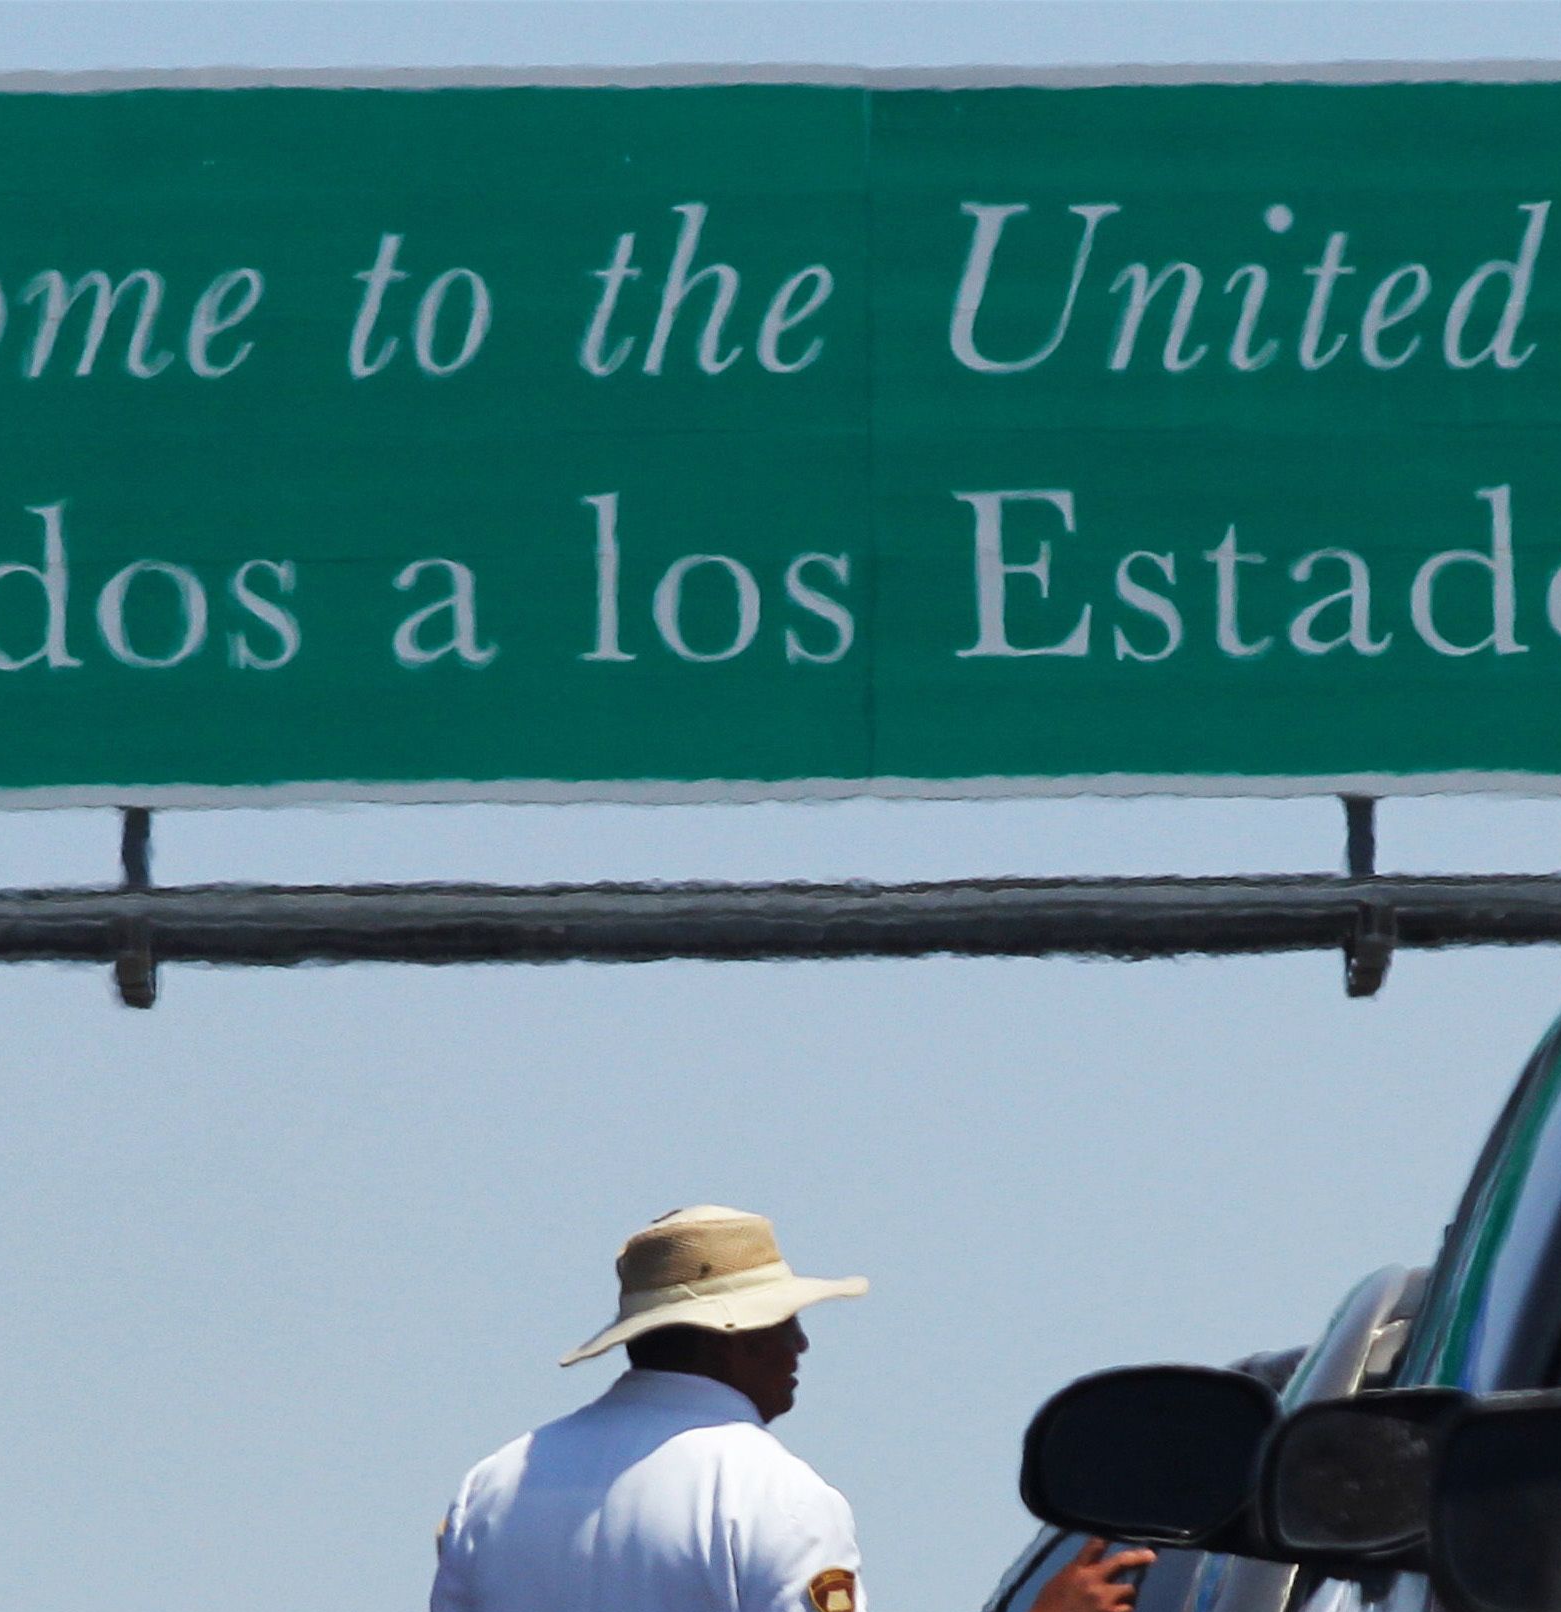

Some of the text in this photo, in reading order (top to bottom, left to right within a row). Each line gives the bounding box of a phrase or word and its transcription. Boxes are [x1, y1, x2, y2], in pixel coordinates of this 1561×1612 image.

[348, 232, 492, 378] to
[581, 203, 834, 377] the
[947, 201, 1552, 374] United
[391, 558, 494, 666] a
[583, 492, 857, 665] los
